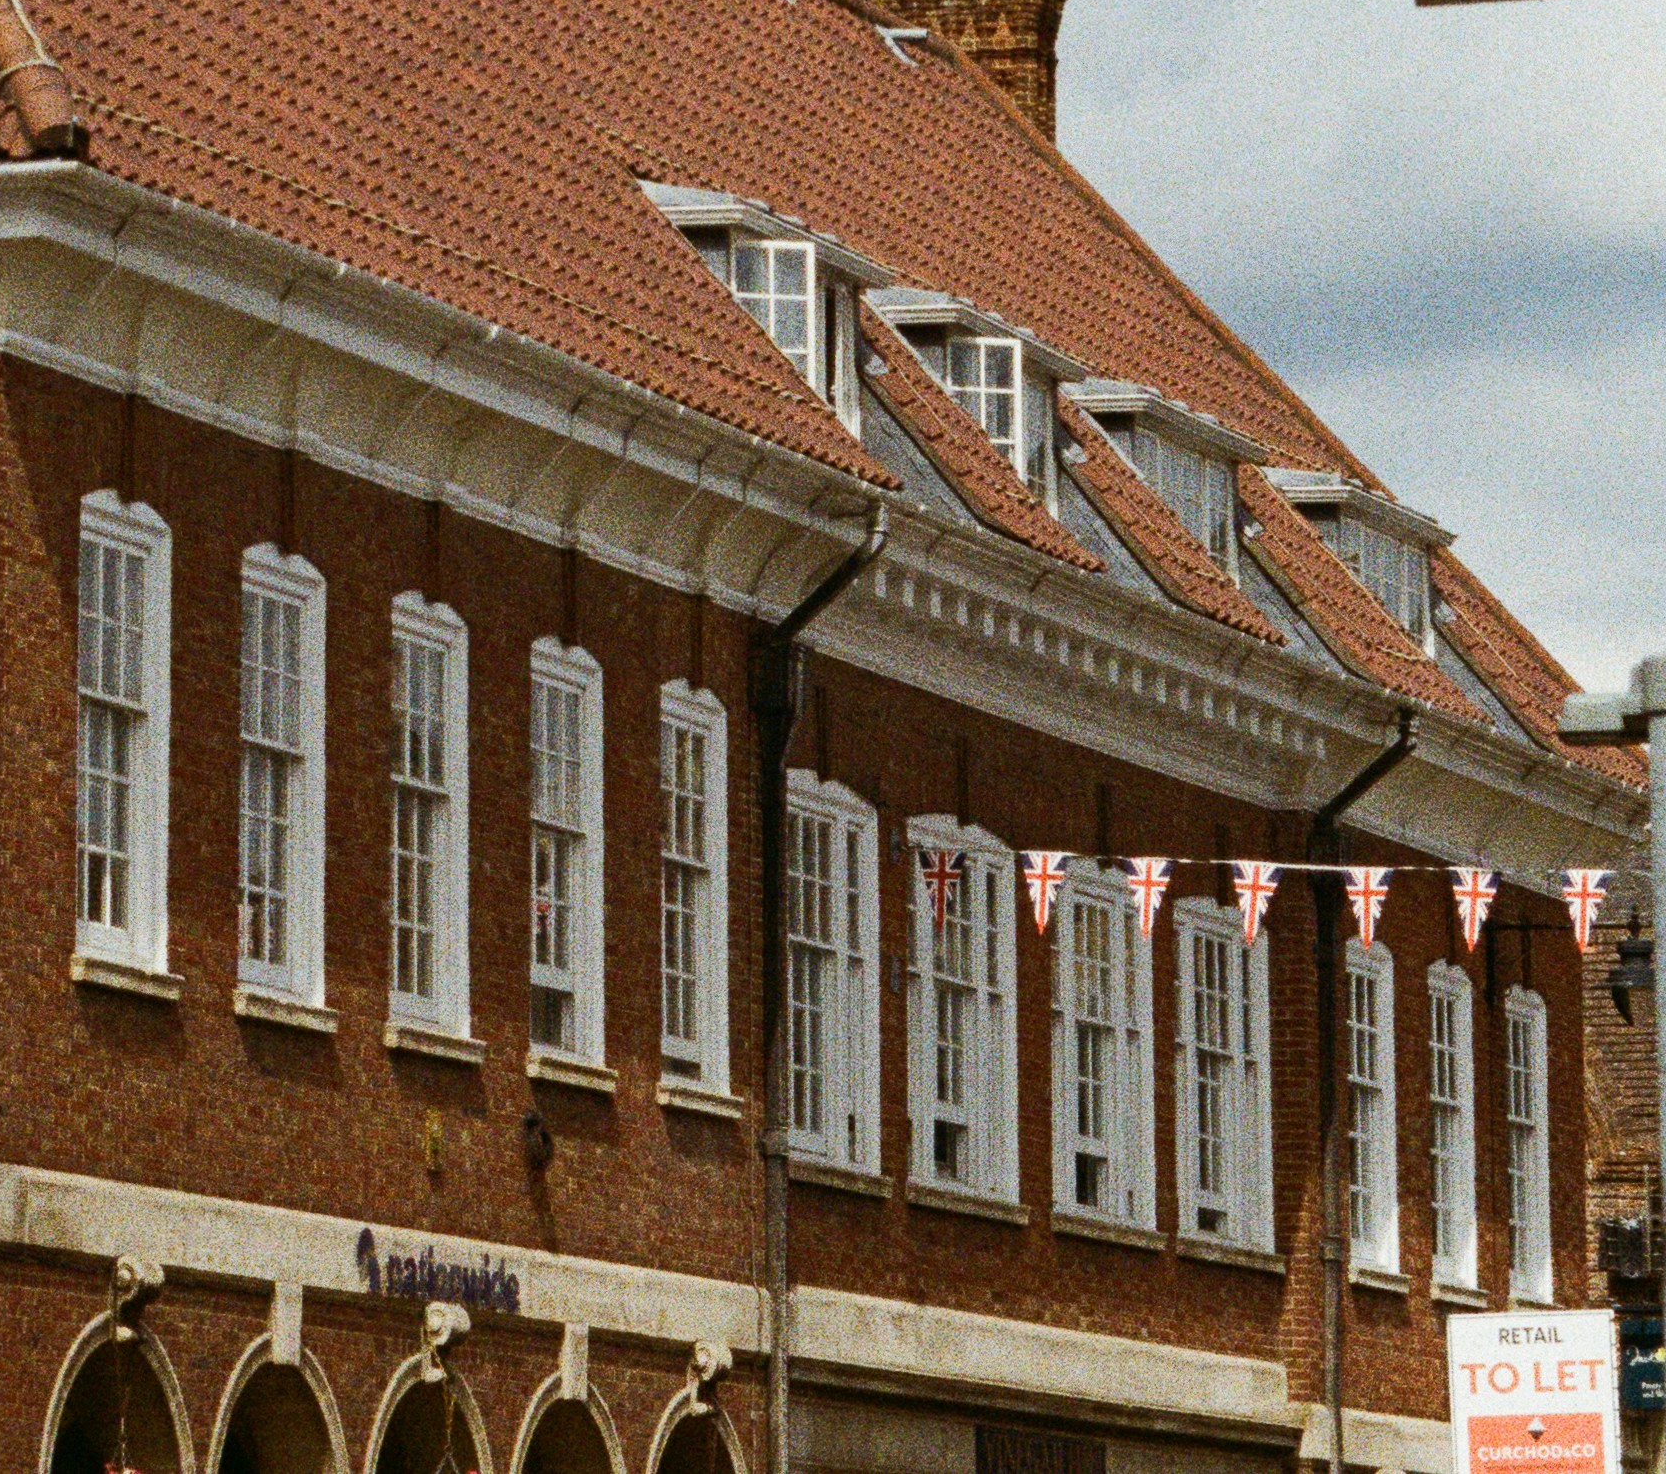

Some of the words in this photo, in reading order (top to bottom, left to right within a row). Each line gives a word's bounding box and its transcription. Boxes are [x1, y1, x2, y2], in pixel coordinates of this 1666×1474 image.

[387, 1245, 521, 1313] nationwide
[1498, 1327, 1564, 1345] RETAIL
[1459, 1362, 1520, 1394] TO
[1533, 1359, 1606, 1392] LET
